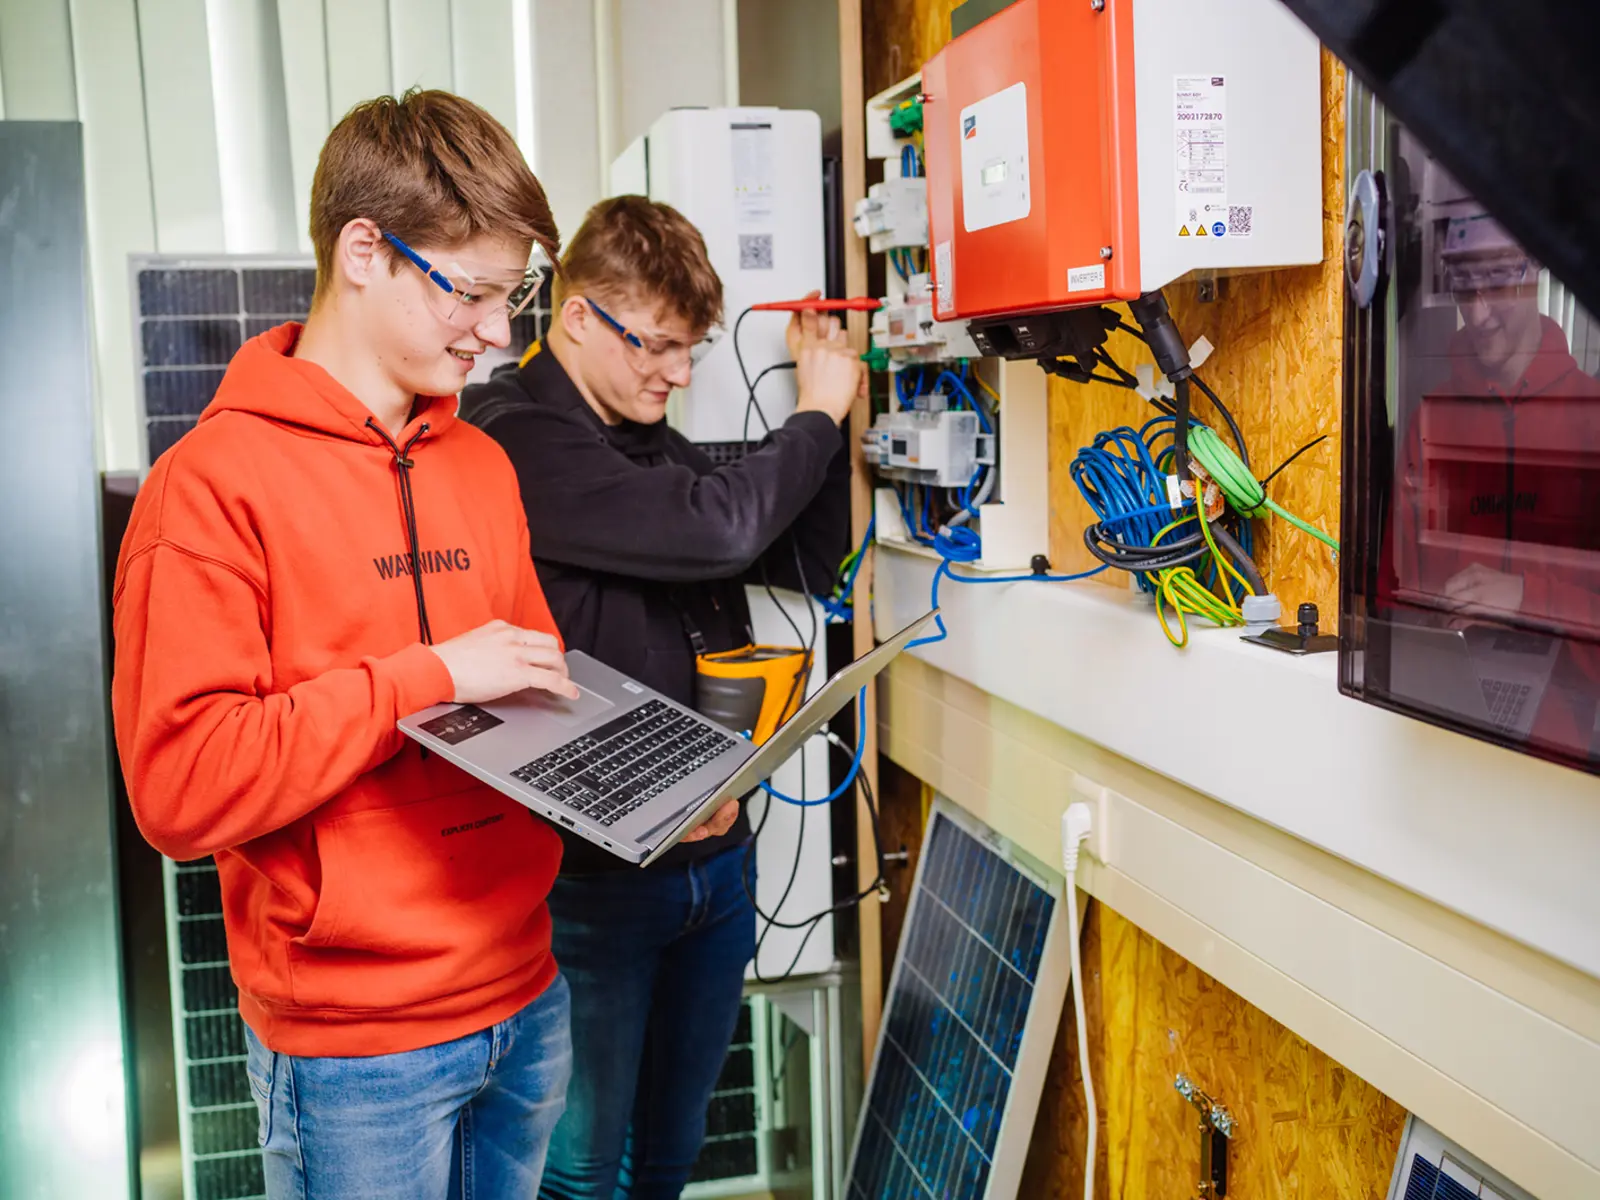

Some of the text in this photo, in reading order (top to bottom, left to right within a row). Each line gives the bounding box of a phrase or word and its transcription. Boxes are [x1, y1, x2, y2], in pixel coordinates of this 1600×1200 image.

[1177, 112, 1222, 121] 2002172870
[441, 813, 504, 837] EXPLICIT CONTENT
